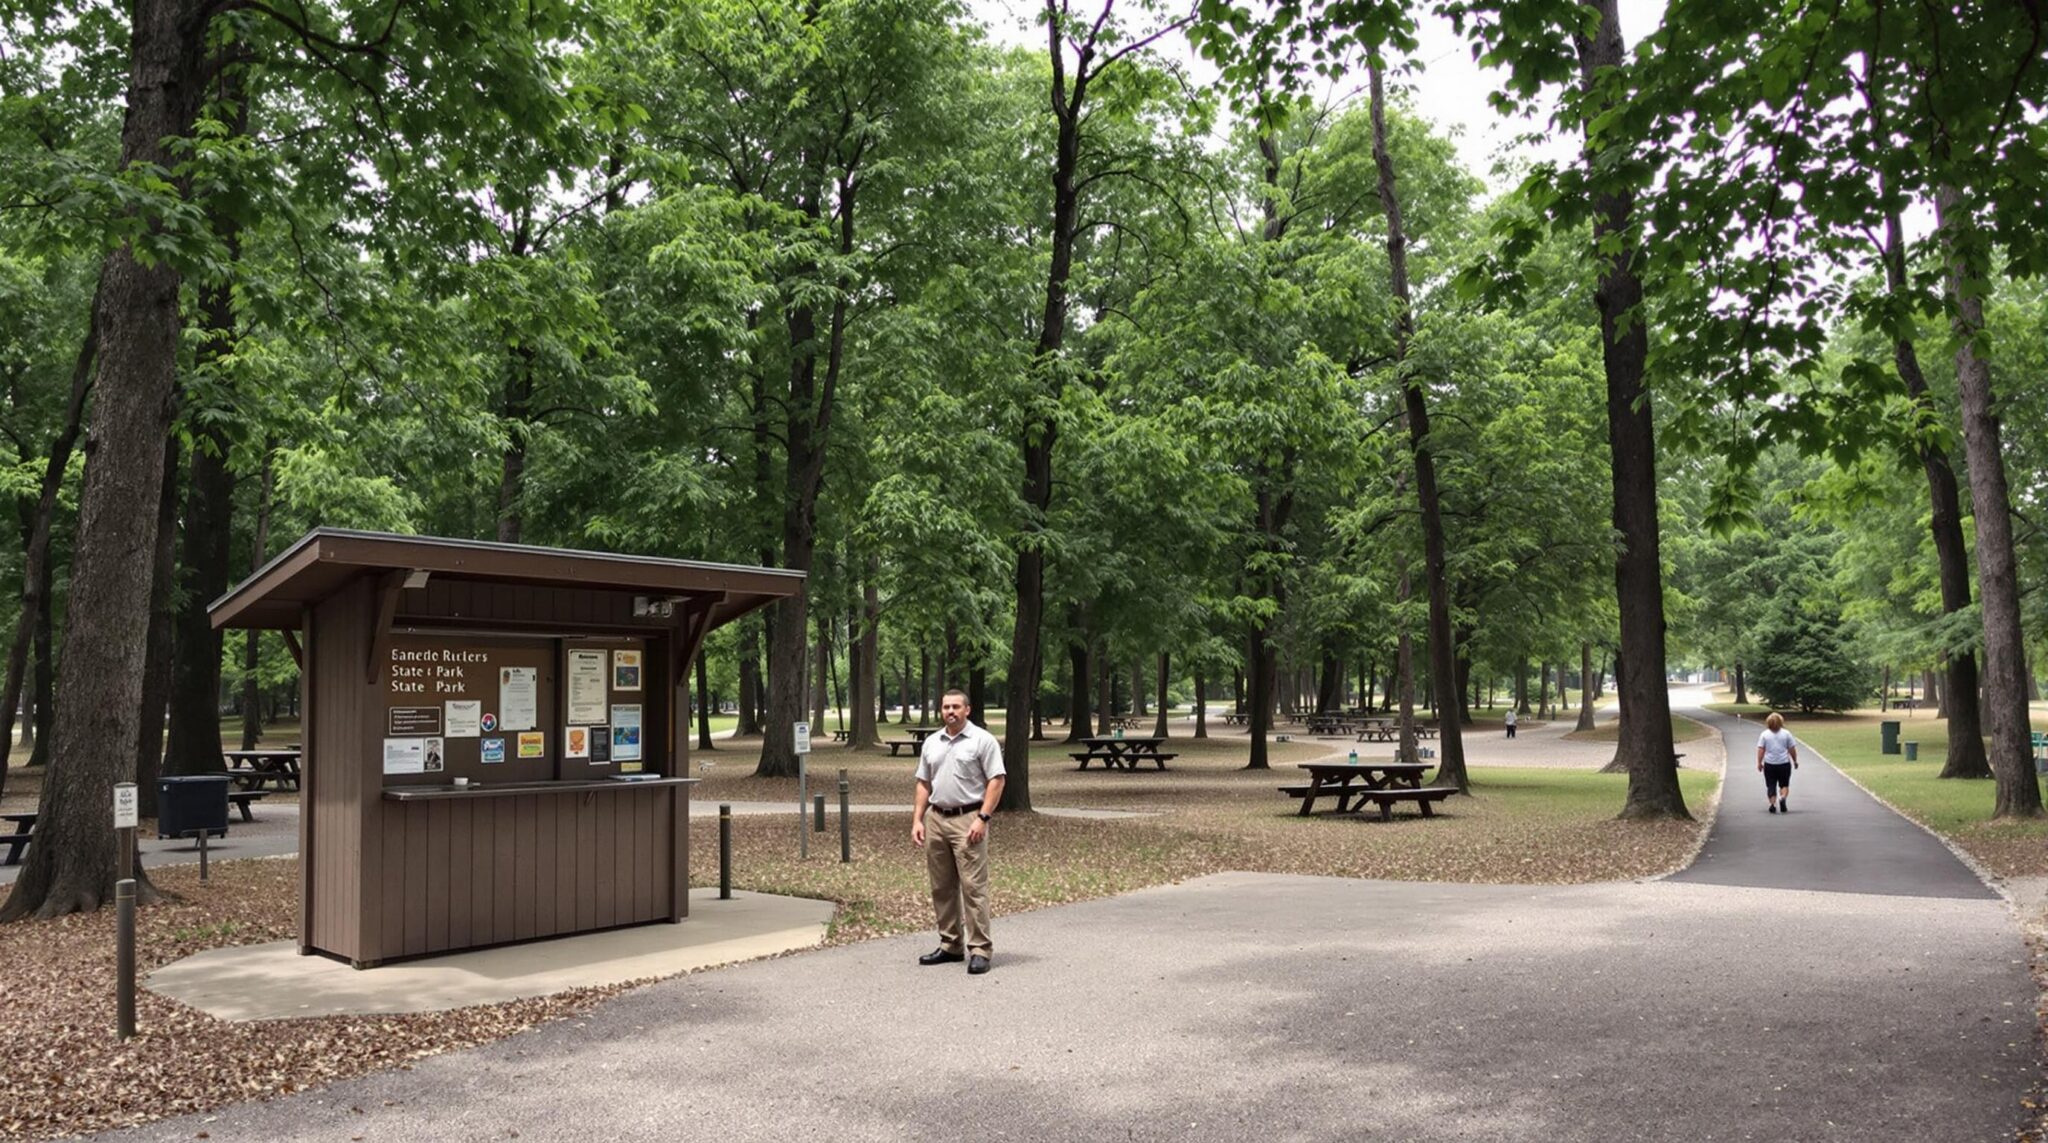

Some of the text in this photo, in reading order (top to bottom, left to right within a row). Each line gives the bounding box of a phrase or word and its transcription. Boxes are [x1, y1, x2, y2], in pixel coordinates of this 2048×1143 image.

[391, 664, 424, 677] State
[436, 665, 464, 678] Park
[391, 680, 466, 693] State Park
